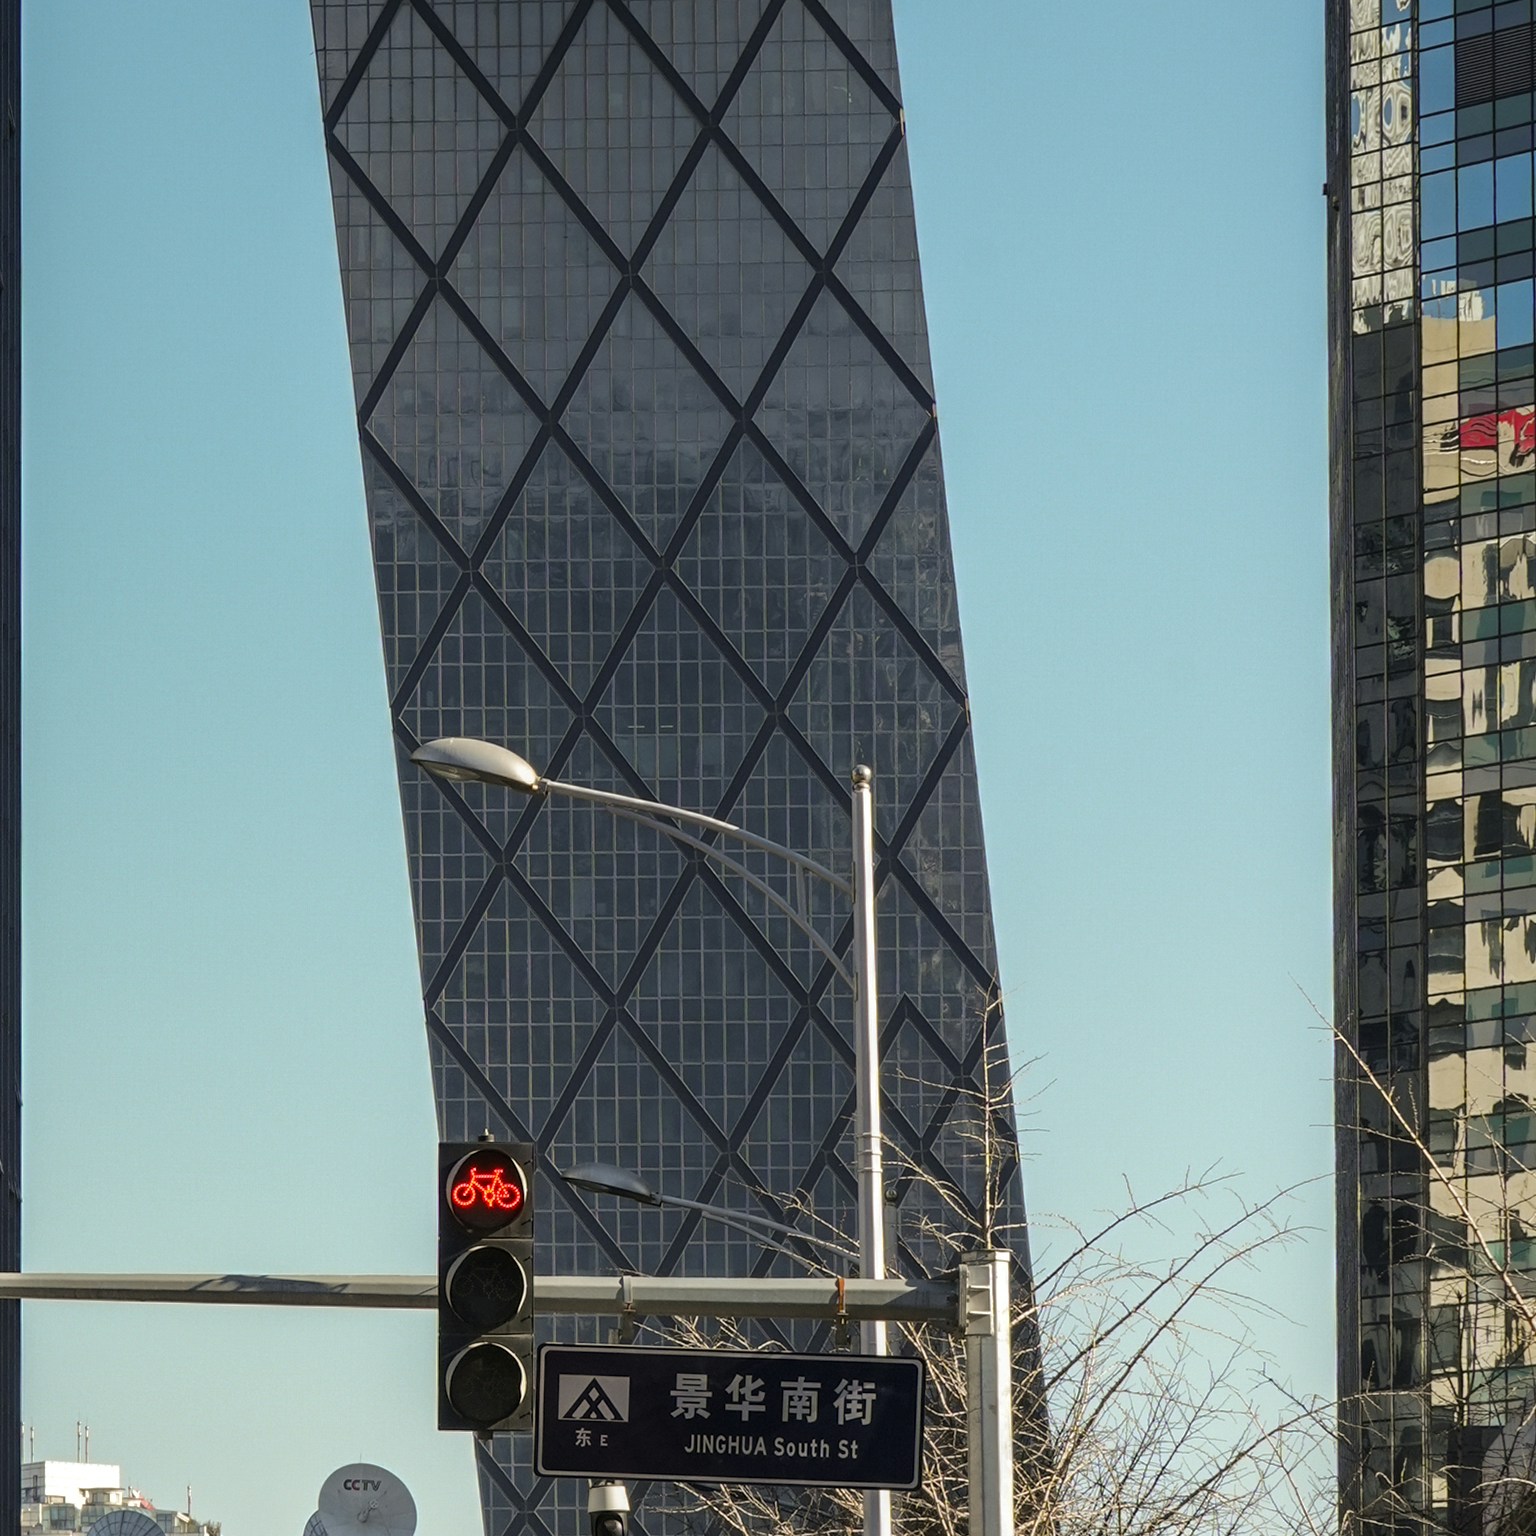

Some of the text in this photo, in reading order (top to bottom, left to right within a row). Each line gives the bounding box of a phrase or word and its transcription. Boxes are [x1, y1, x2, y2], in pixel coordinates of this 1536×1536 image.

[670, 1373, 878, 1426] 景华南街
[575, 1428, 592, 1447] 东
[600, 1435, 609, 1447] E
[684, 1434, 859, 1460] JINGHUA South St
[343, 1479, 382, 1492] CCTV
